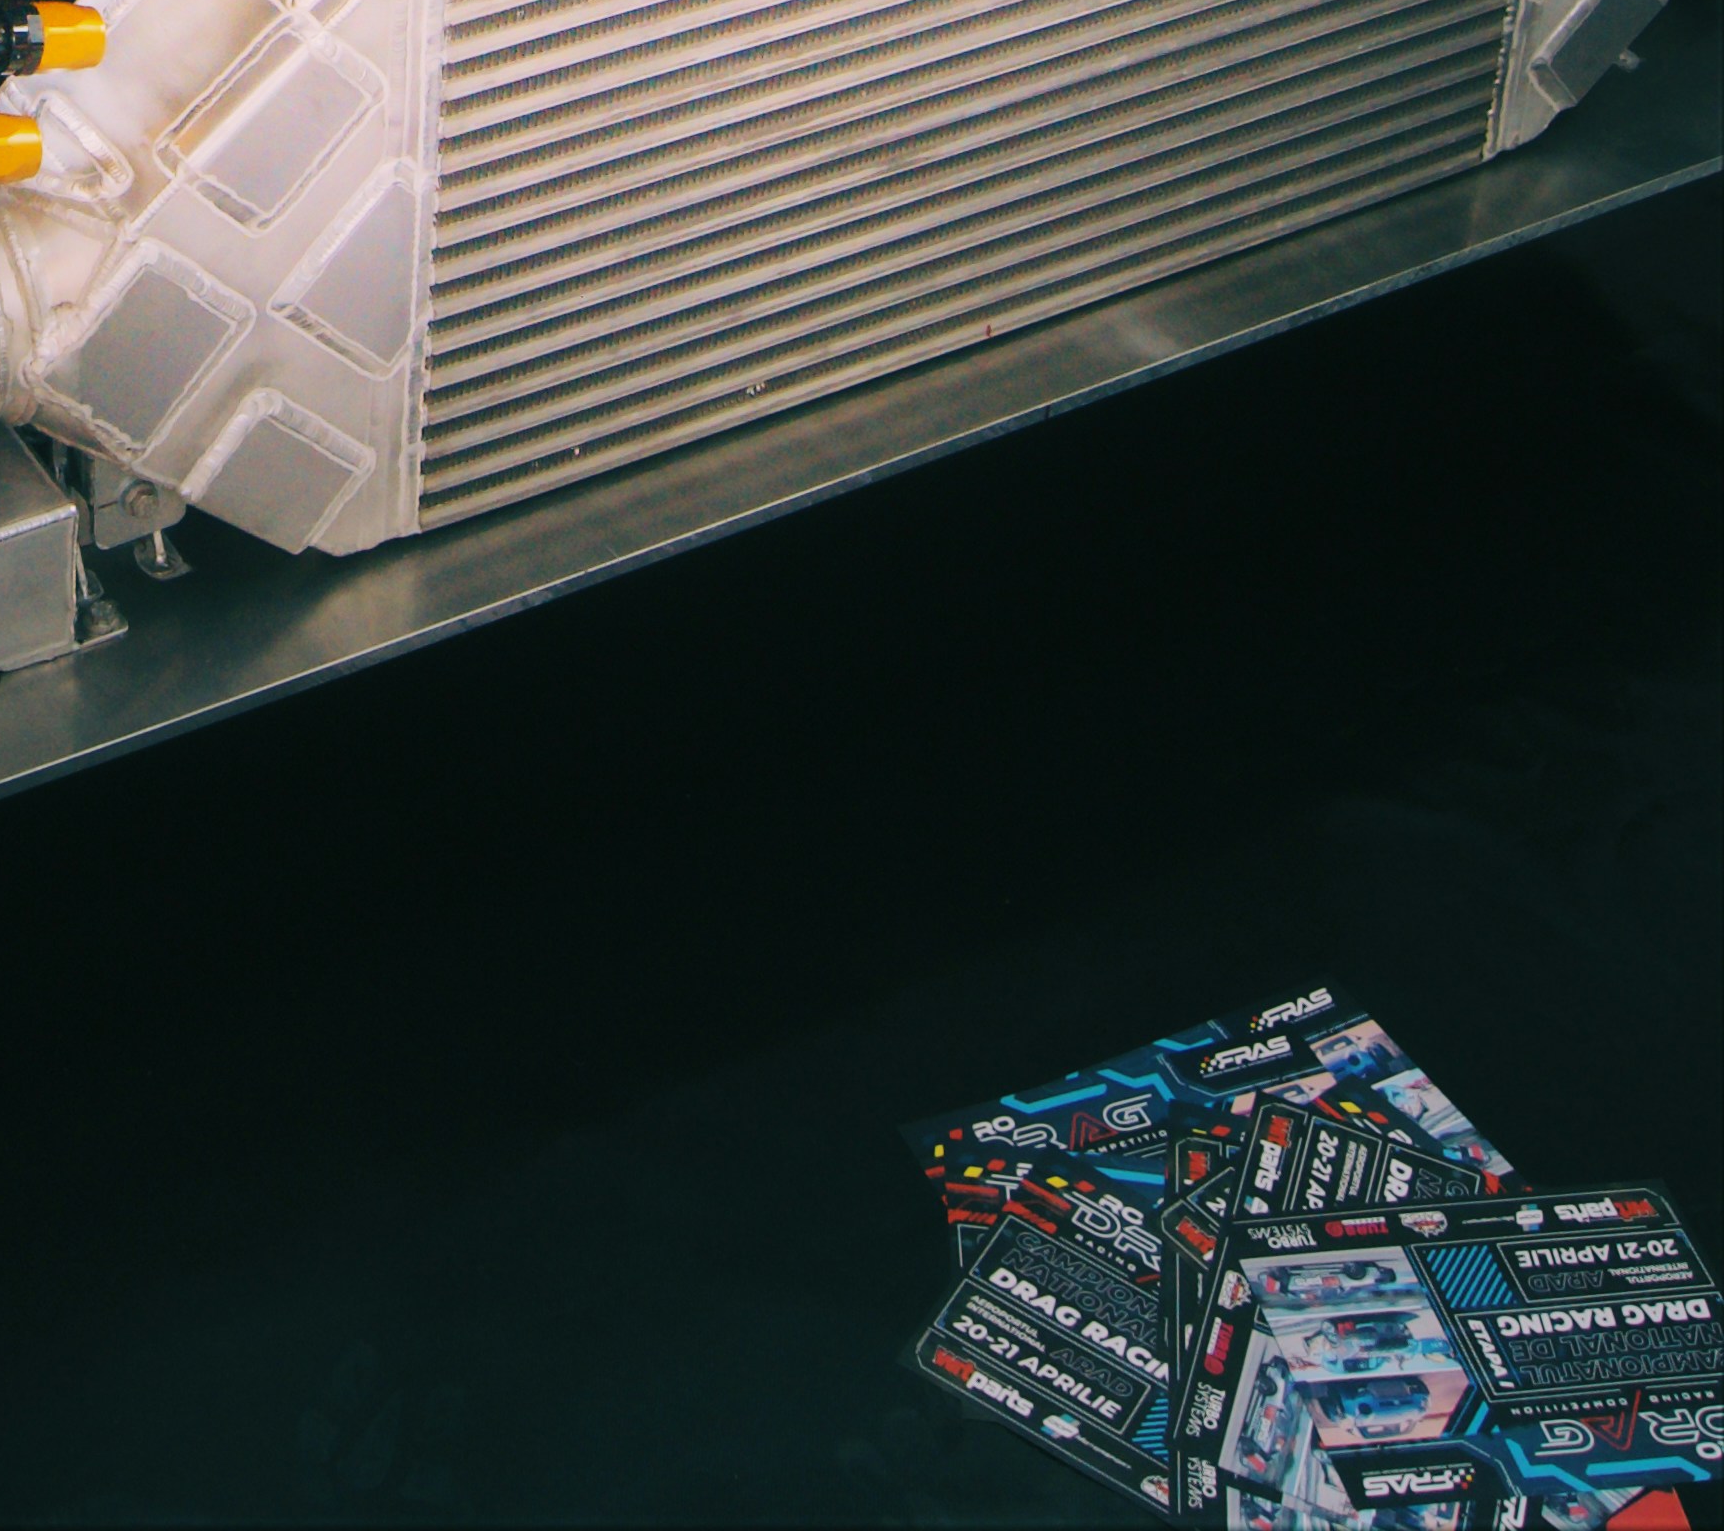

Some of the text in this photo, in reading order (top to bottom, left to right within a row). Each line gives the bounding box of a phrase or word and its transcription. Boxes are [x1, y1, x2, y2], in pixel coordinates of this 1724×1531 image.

[1261, 986, 1334, 1028] FRAS
[1214, 1034, 1292, 1070] FRAS
[978, 1092, 1153, 1151] RAG
[1074, 1232, 1137, 1273] RACING
[1514, 1238, 1679, 1268] 20-21 APRILIE
[1527, 1261, 1690, 1293] INTERNATIONAL ARAD
[988, 1267, 1082, 1328] DRAG
[1080, 1320, 1169, 1383] RACIN
[1496, 1298, 1712, 1338] DRAG RACING
[1467, 1318, 1508, 1380] ETAPA
[1507, 1320, 1724, 1362] NATIONAL DE
[952, 1314, 1123, 1420] 20-21 APRILIE
[1049, 1347, 1134, 1398] ARAD
[1511, 1389, 1715, 1416] RACING COMPETITION
[1187, 1456, 1204, 1510] YSTEMS
[1200, 1458, 1219, 1499] URBO
[1362, 1470, 1460, 1498] FRAS
